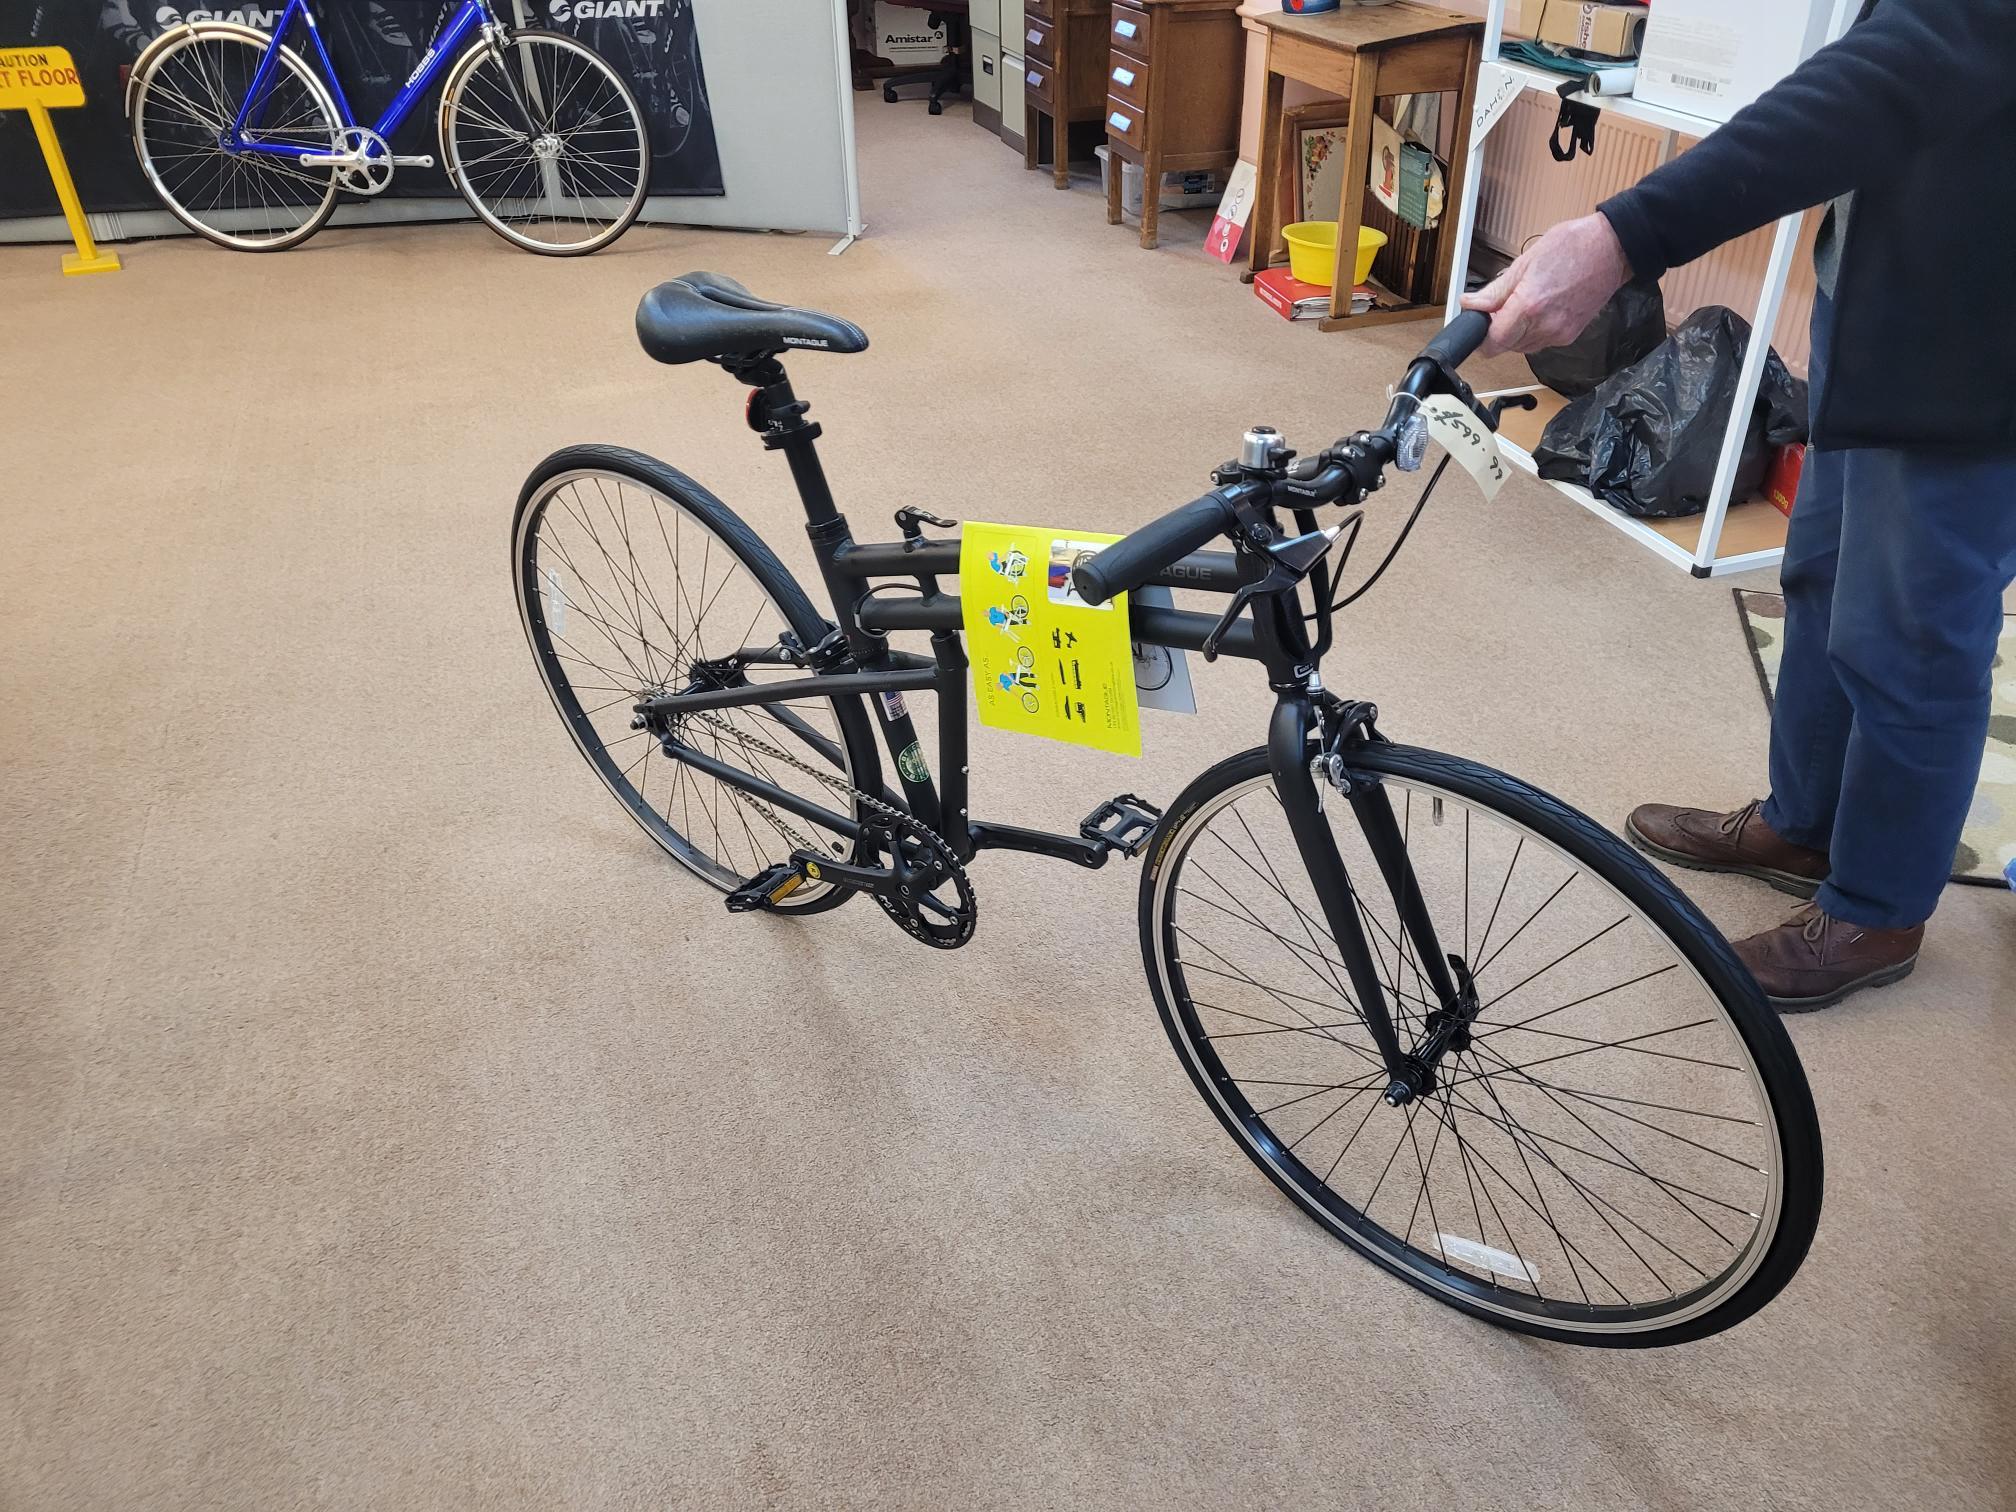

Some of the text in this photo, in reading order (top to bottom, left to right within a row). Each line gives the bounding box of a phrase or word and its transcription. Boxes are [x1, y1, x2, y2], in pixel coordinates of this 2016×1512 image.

[574, 1, 663, 18] GIANT
[885, 34, 933, 43] Amistar
[405, 48, 436, 88] HOBBS
[17, 67, 80, 87] FLOOR
[782, 336, 828, 347] MONTAGUE
